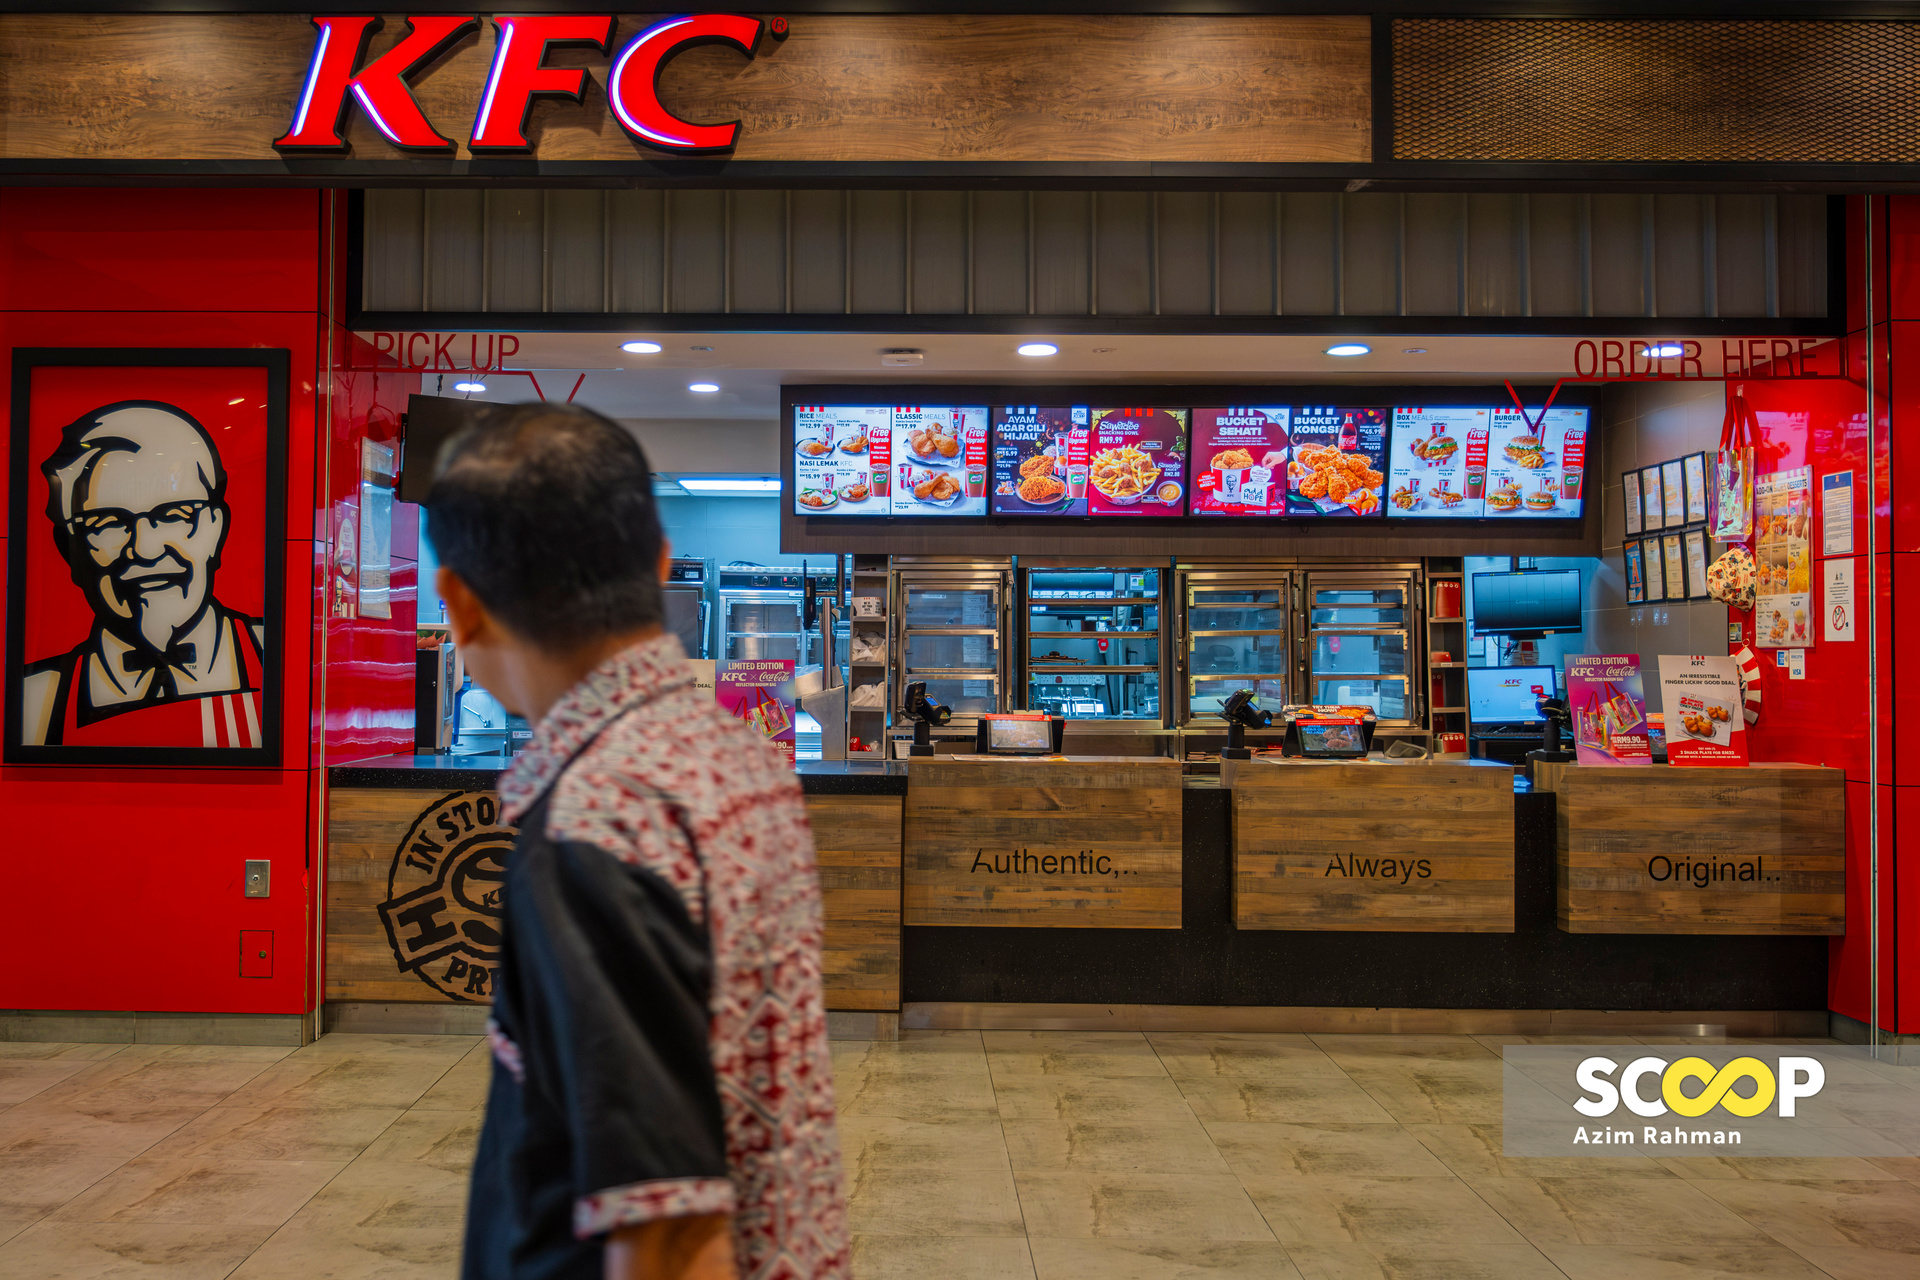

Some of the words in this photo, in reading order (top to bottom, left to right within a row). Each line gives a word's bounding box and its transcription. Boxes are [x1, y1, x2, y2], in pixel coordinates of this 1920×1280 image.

[272, 15, 764, 155] KFC
[373, 332, 457, 371] PICK
[471, 334, 520, 372] UP
[1574, 340, 1703, 379] ORDER
[1722, 339, 1819, 377] HERE
[1216, 417, 1265, 426] BUCKET
[872, 427, 889, 436] Free
[968, 428, 985, 437] Free
[1070, 428, 1088, 438] Free
[1219, 427, 1262, 436] SEHATI
[1470, 428, 1486, 438] Free
[1567, 429, 1584, 439] Free
[721, 672, 747, 681] KFC
[1570, 668, 1594, 676] KFC
[405, 830, 444, 875] IN
[436, 796, 501, 842] STO
[1325, 852, 1432, 885] Always
